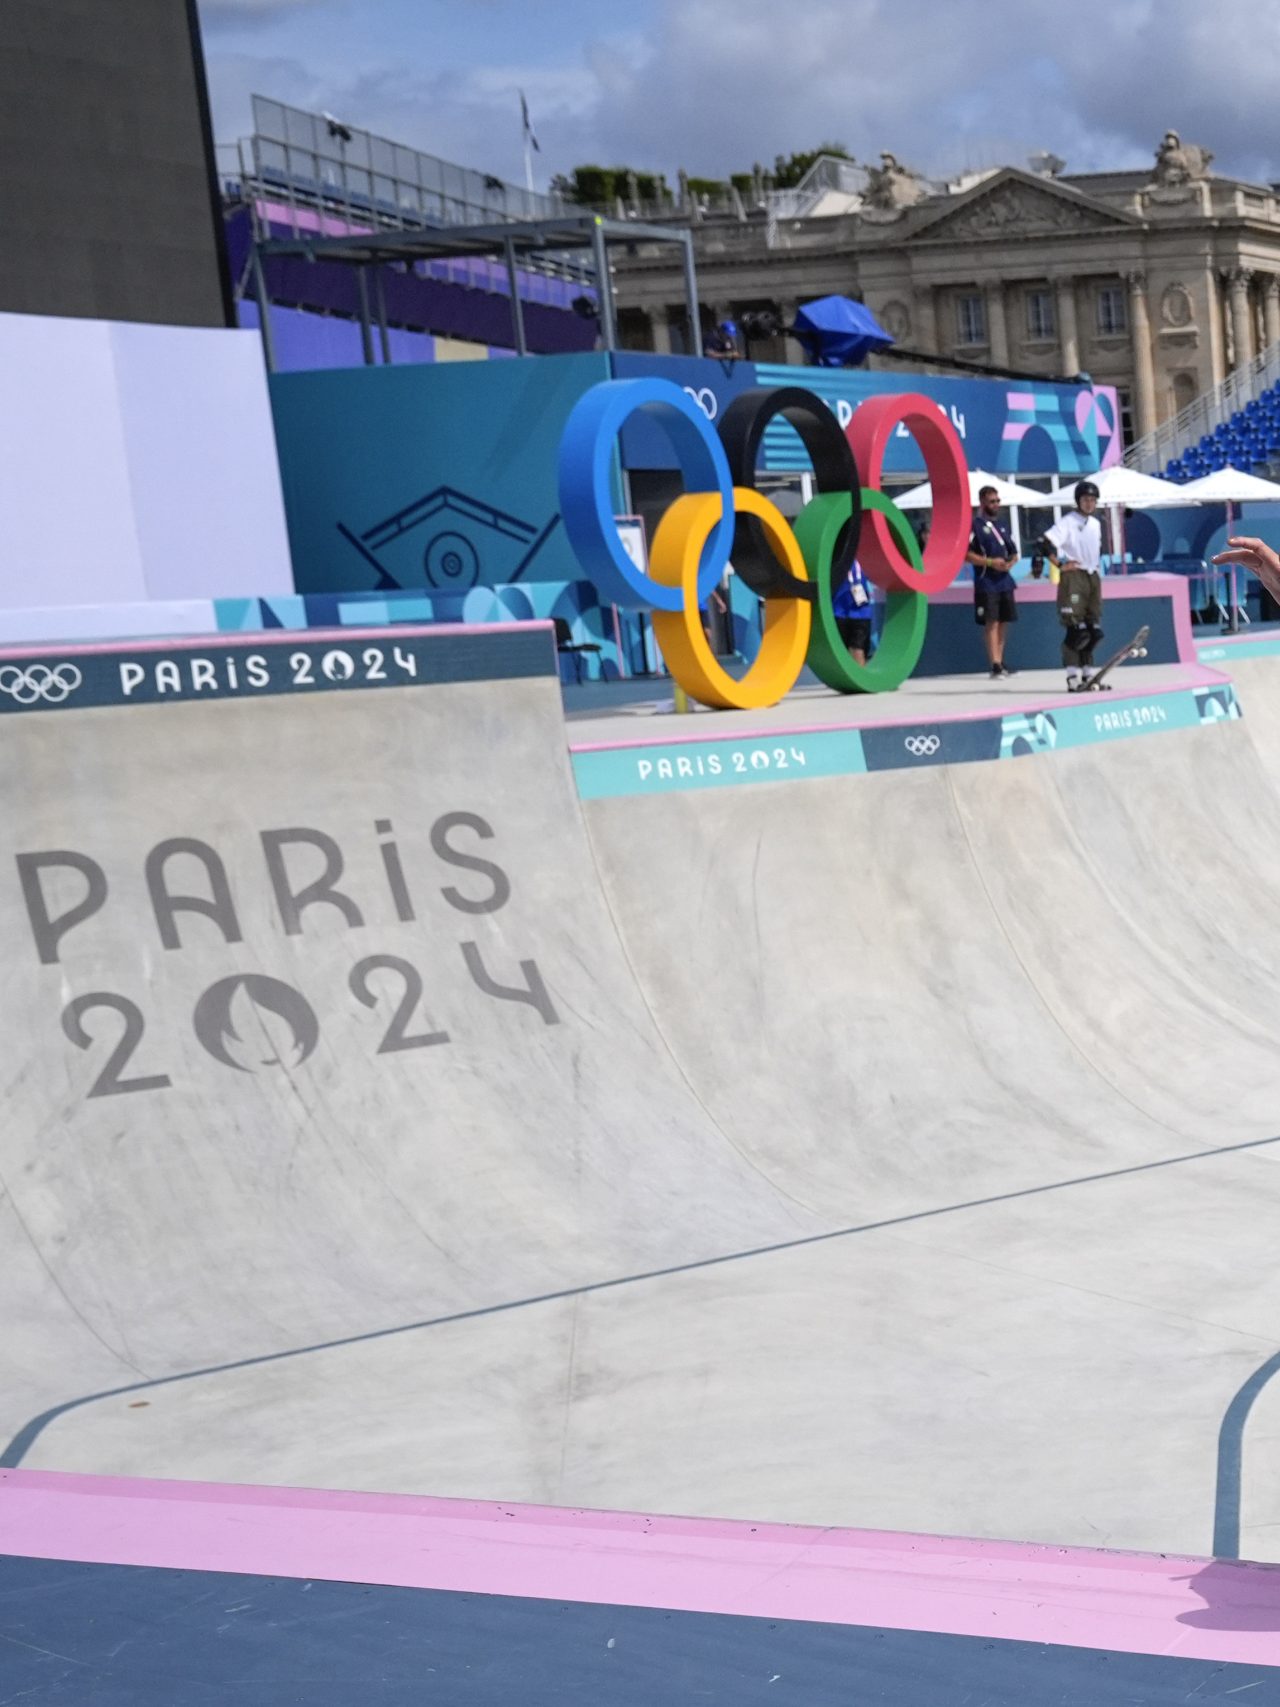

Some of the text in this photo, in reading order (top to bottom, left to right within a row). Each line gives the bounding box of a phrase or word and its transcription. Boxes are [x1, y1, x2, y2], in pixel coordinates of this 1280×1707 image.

[120, 646, 418, 696] PARiS 2024
[1134, 705, 1167, 729] 2024
[732, 747, 806, 773] 2024
[15, 811, 512, 965] PARiS
[60, 941, 562, 1099] 2024
